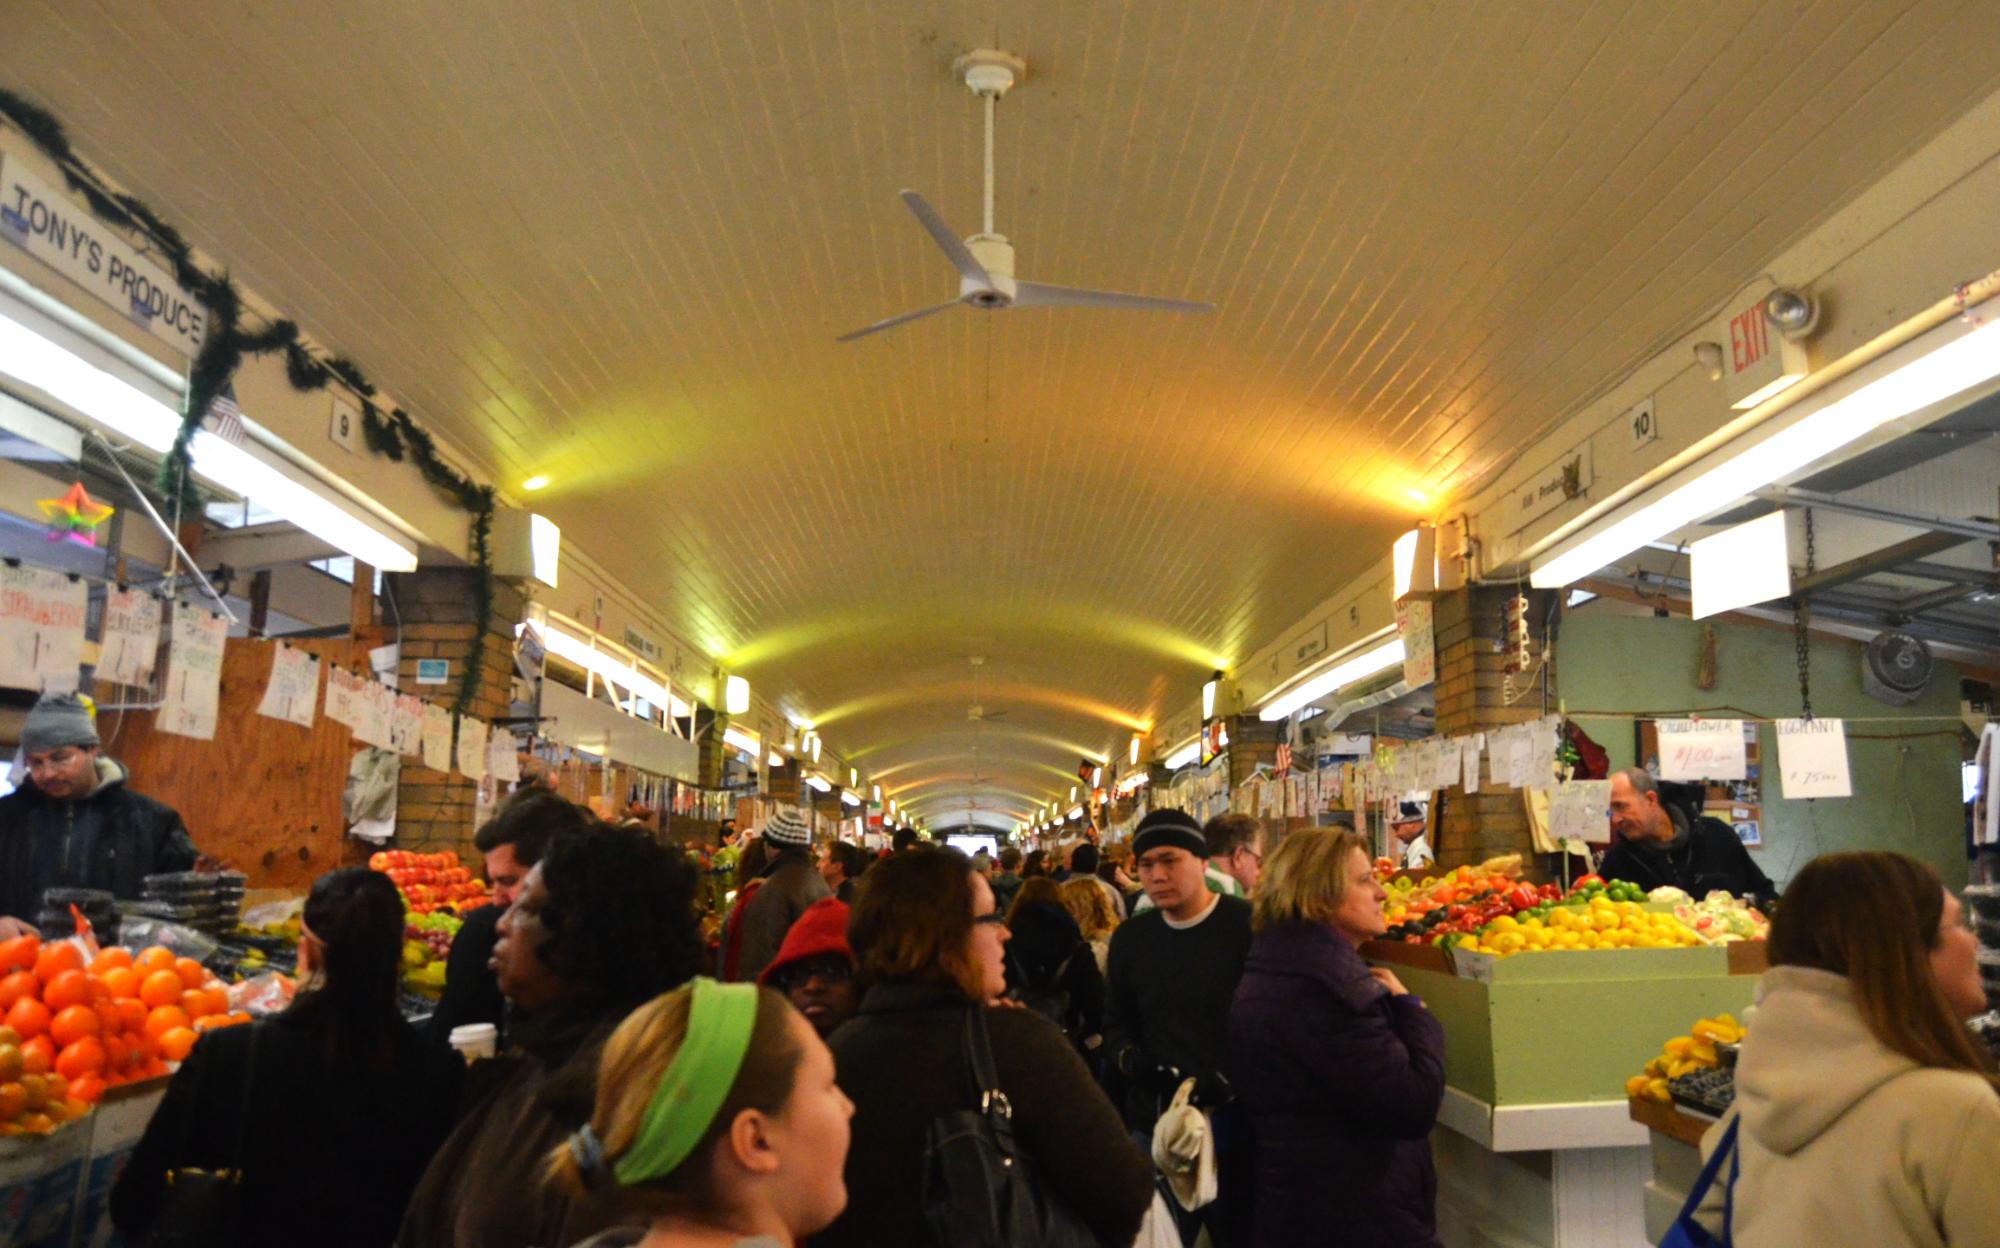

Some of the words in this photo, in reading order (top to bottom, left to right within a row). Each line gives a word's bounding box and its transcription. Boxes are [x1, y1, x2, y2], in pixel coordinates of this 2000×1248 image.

[14, 183, 103, 273] TONY'S
[108, 255, 202, 344] PRODUCE
[1730, 300, 1769, 374] EXIT
[1633, 411, 1650, 440] 10
